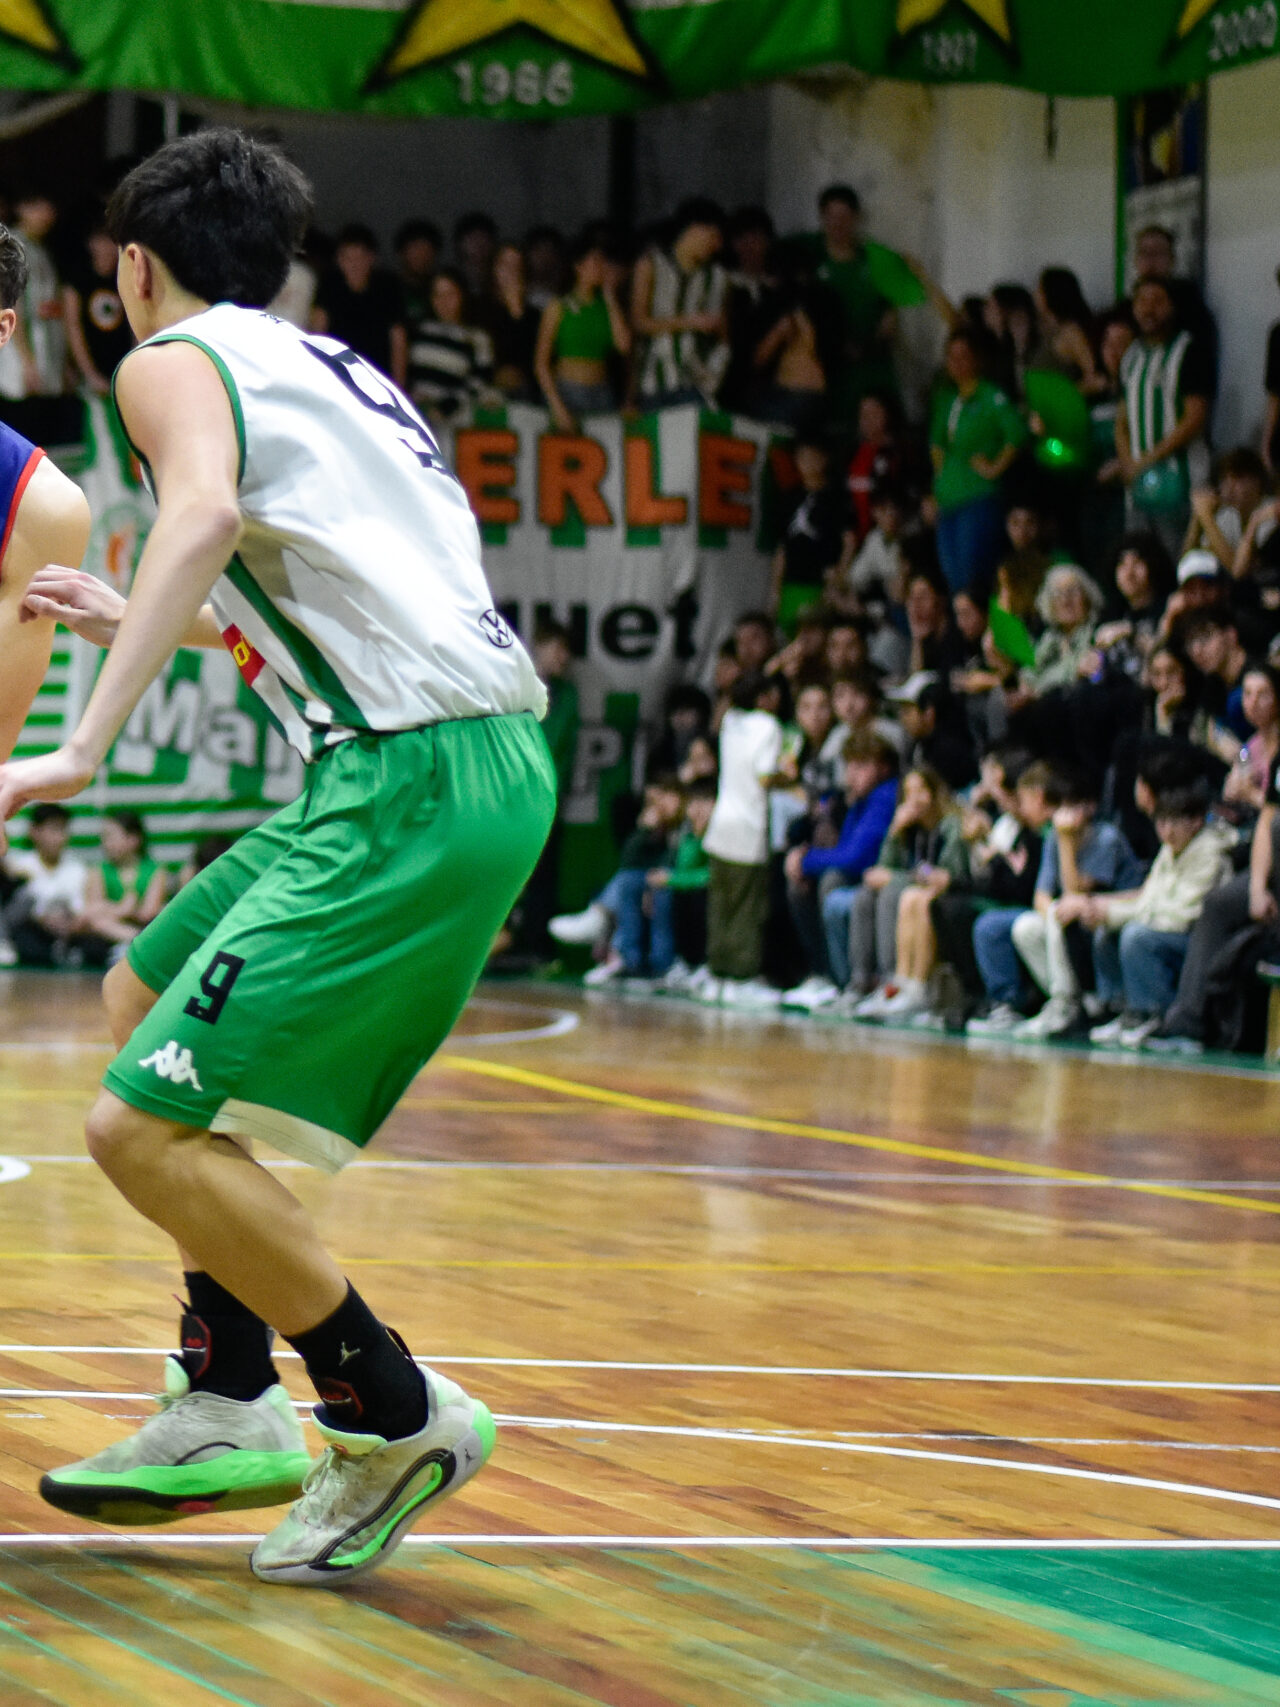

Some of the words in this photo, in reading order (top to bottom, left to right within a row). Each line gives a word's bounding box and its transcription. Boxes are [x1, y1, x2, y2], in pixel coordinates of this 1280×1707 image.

[454, 429, 803, 528] ERLE
[498, 587, 700, 661] uet
[182, 950, 247, 1027] 9
